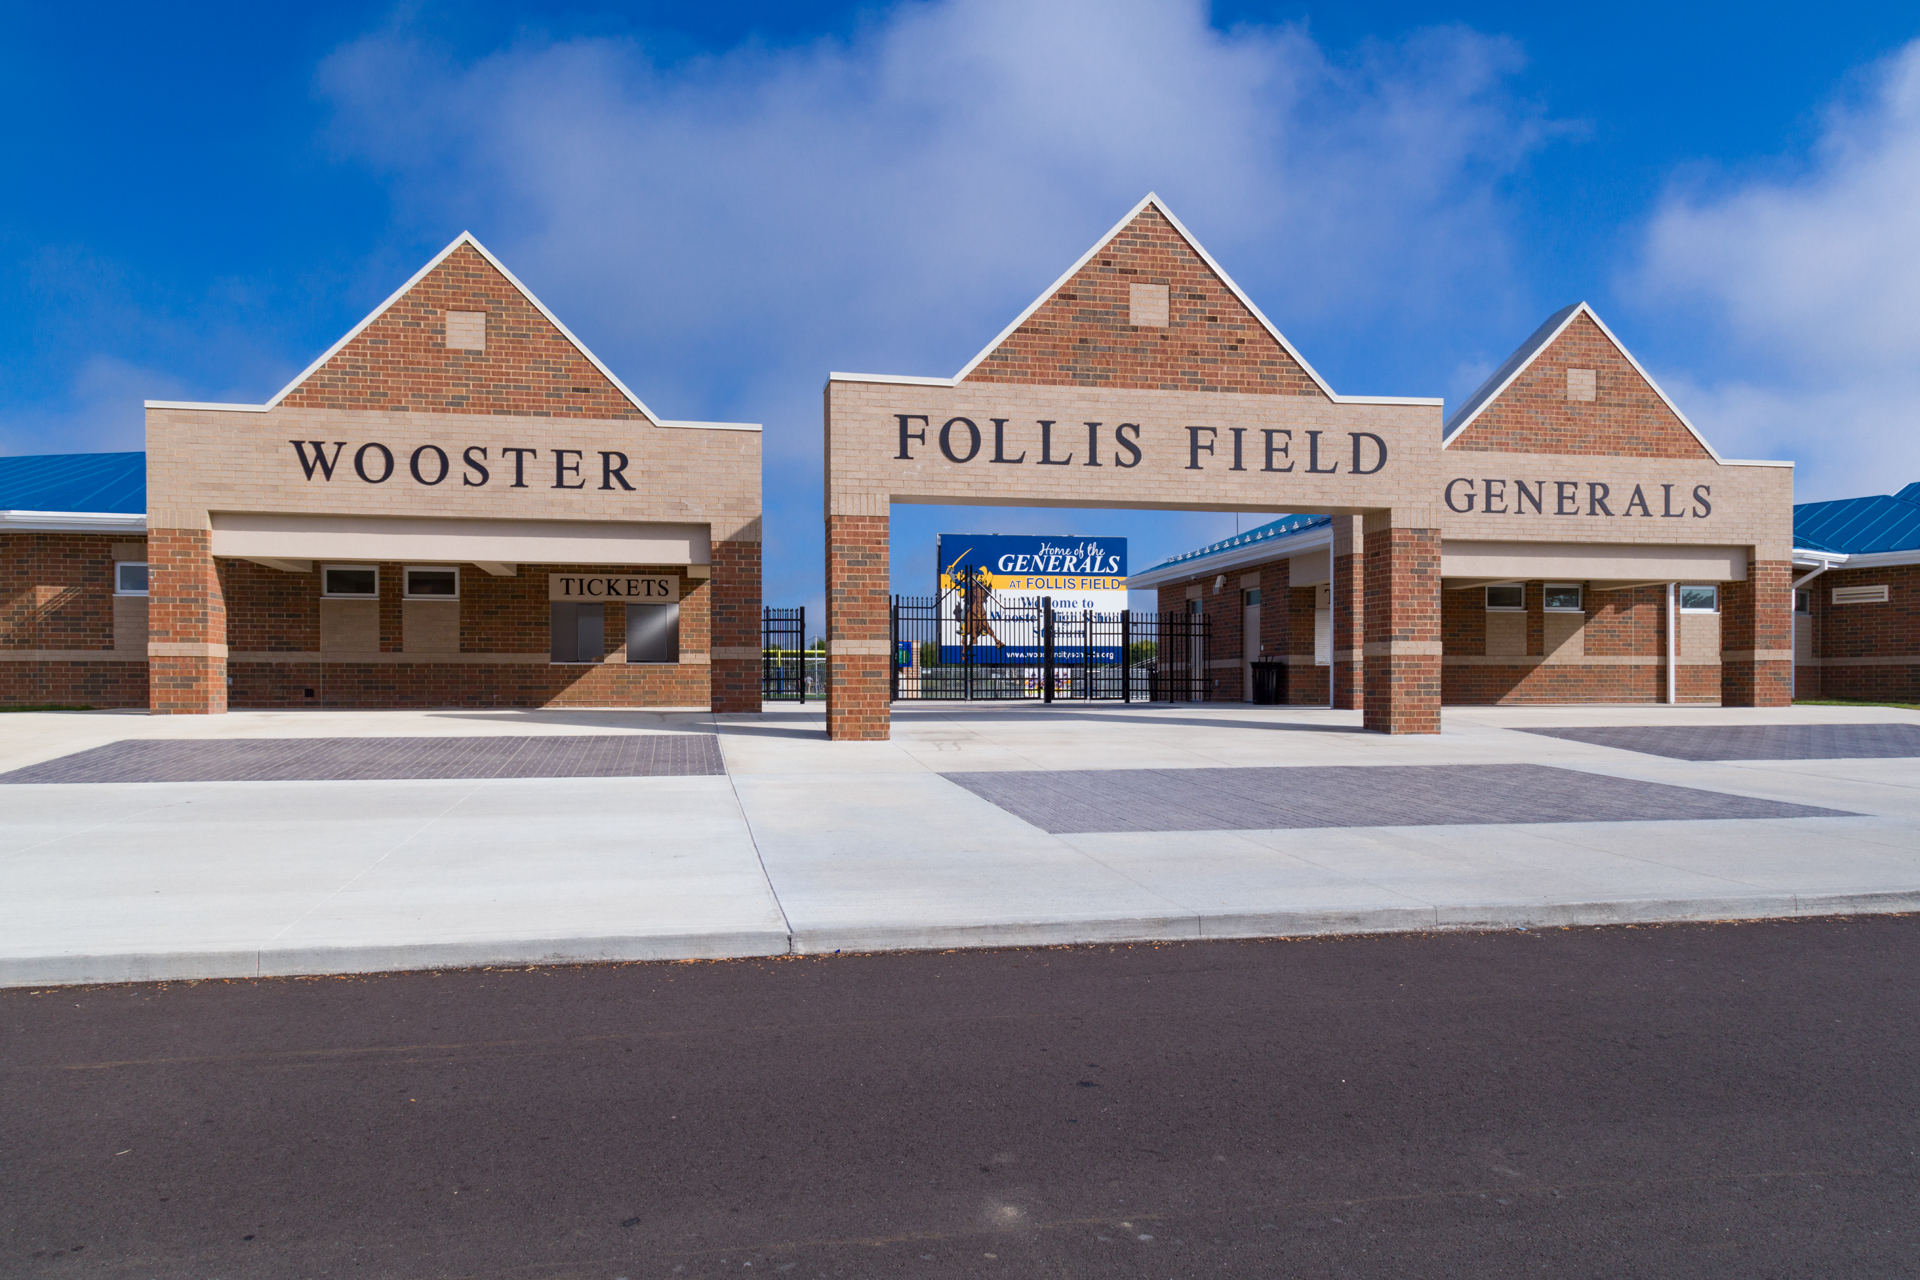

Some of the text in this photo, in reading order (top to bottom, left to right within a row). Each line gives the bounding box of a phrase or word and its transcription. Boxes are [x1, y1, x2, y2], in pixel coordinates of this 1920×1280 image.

[893, 414, 1388, 475] FOLLIS FIELD
[288, 440, 638, 491] WOOSTER
[1444, 478, 1712, 519] GENERALS
[1038, 541, 1106, 559] Home of the
[997, 553, 1121, 573] GENERALS
[559, 576, 671, 598] TICKETS
[1009, 578, 1121, 590] AT FOLLIS FIELD
[1082, 598, 1094, 608] to
